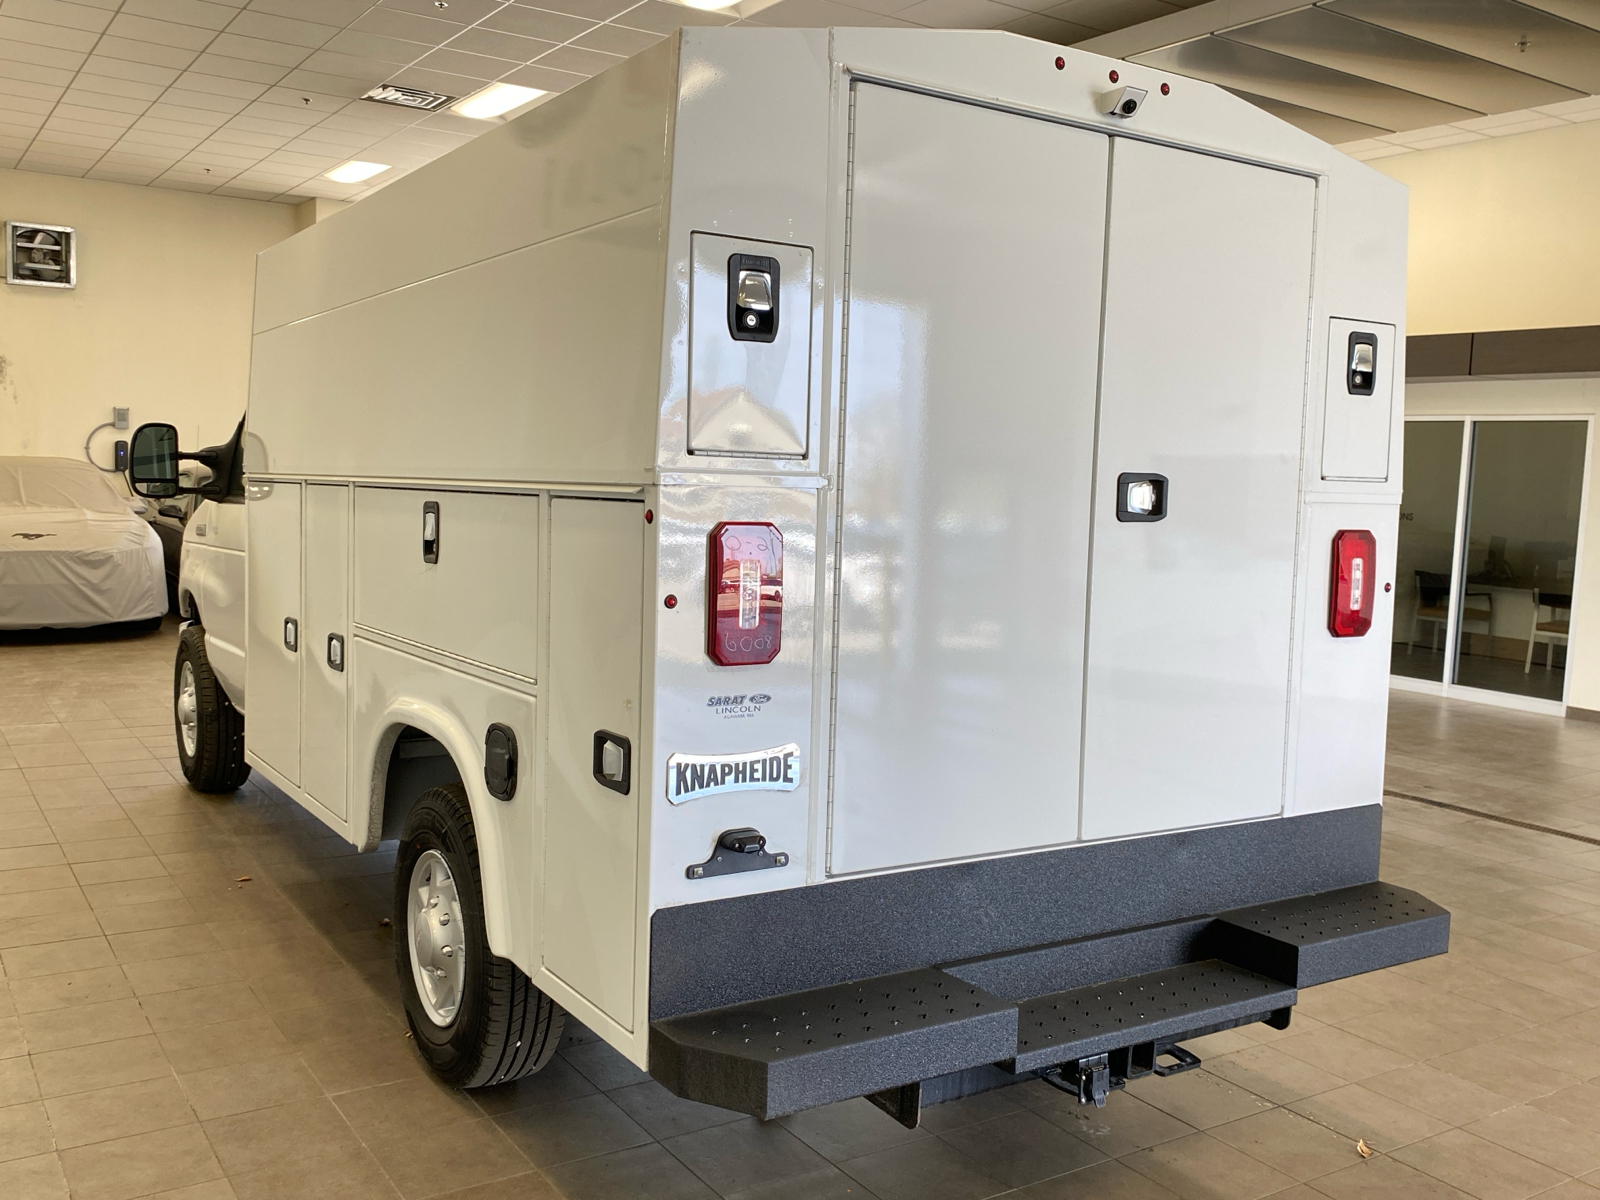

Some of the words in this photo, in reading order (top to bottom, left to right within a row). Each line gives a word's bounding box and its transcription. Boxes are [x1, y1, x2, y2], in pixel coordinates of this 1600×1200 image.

[725, 632, 772, 652] 6008
[707, 694, 747, 707] SARAT
[751, 694, 770, 703] Ford
[715, 705, 761, 714] LINCOLN
[675, 751, 794, 797] KNAPHEIDE
